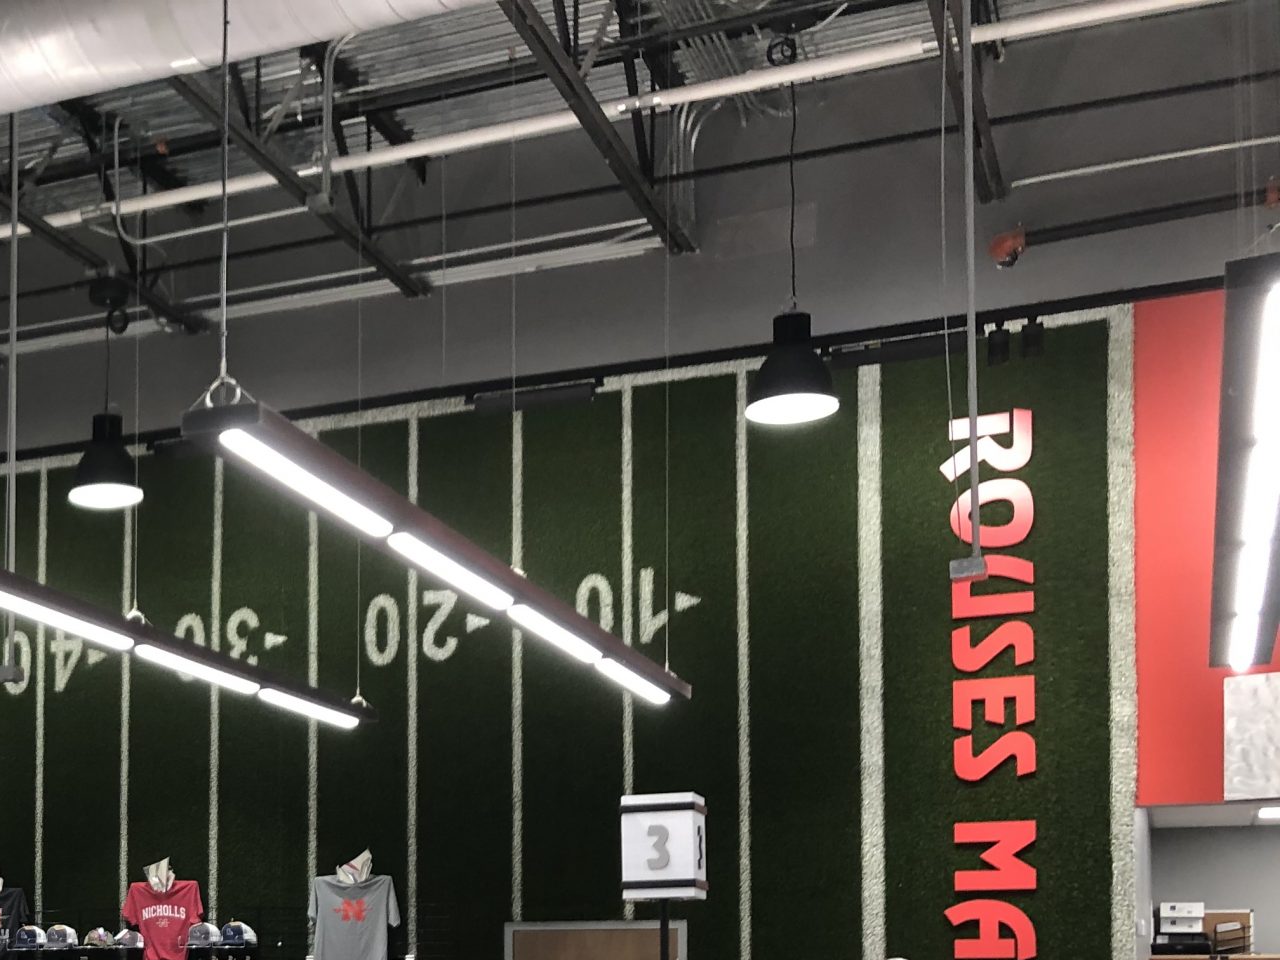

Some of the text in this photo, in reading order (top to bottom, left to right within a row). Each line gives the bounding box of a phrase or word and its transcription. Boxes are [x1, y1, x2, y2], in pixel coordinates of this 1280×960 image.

[939, 407, 1037, 783] ROUSES
[364, 589, 458, 667] 20
[645, 824, 672, 871] 3
[141, 905, 187, 921] NICHOLLS
